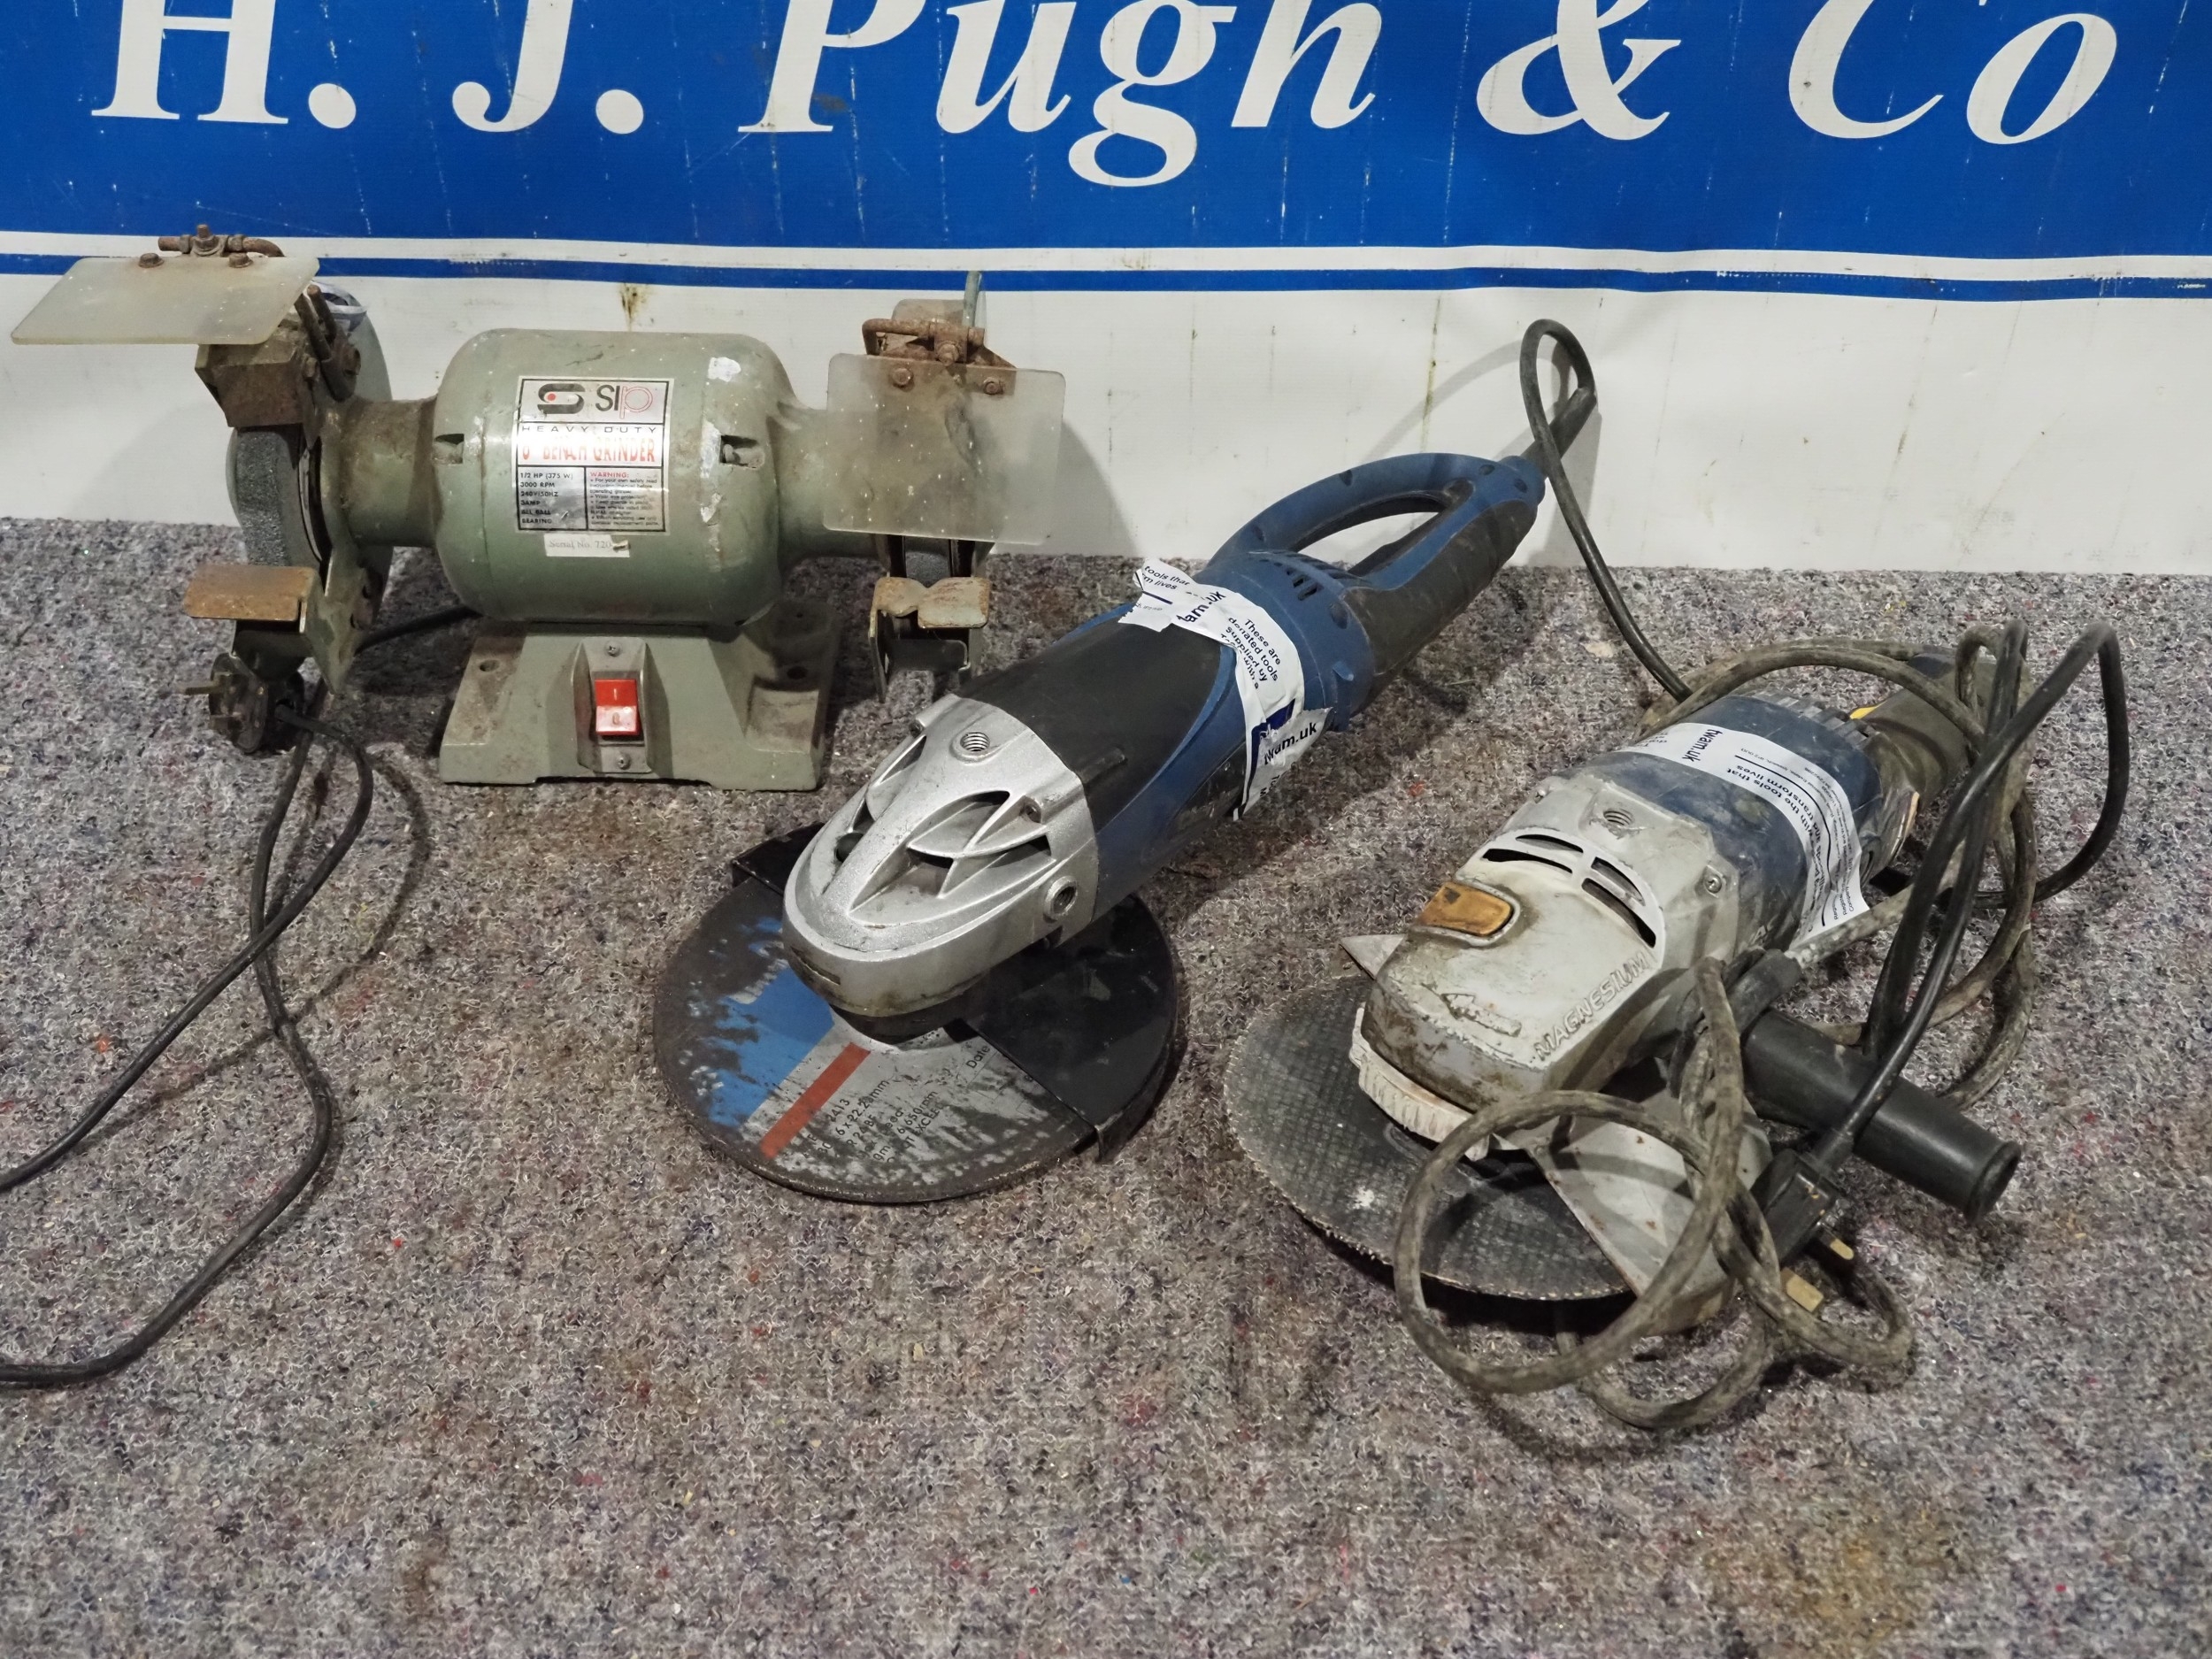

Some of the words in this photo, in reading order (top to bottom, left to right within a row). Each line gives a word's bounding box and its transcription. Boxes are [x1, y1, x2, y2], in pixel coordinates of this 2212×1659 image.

[91, 0, 356, 129] H.
[452, 0, 644, 134] J.
[738, 0, 1382, 188] Pugh
[1476, 0, 1682, 140] &
[1788, 0, 2117, 144] Co
[593, 437, 656, 462] GRINDER
[1144, 565, 1171, 581] tools
[1155, 580, 1178, 590] lives
[1228, 617, 1263, 655] donated
[1260, 652, 1279, 681] tools
[1245, 618, 1270, 647] These
[1269, 648, 1281, 665] are
[1682, 728, 1724, 762] twam.uk
[1726, 767, 1750, 781] that
[1736, 764, 1763, 780] lives
[1753, 779, 1781, 799] tools
[1767, 778, 1814, 821] transform
[1784, 797, 1800, 814] the
[1534, 948, 1649, 1062] MAGNESIUM
[965, 1044, 991, 1070] Date
